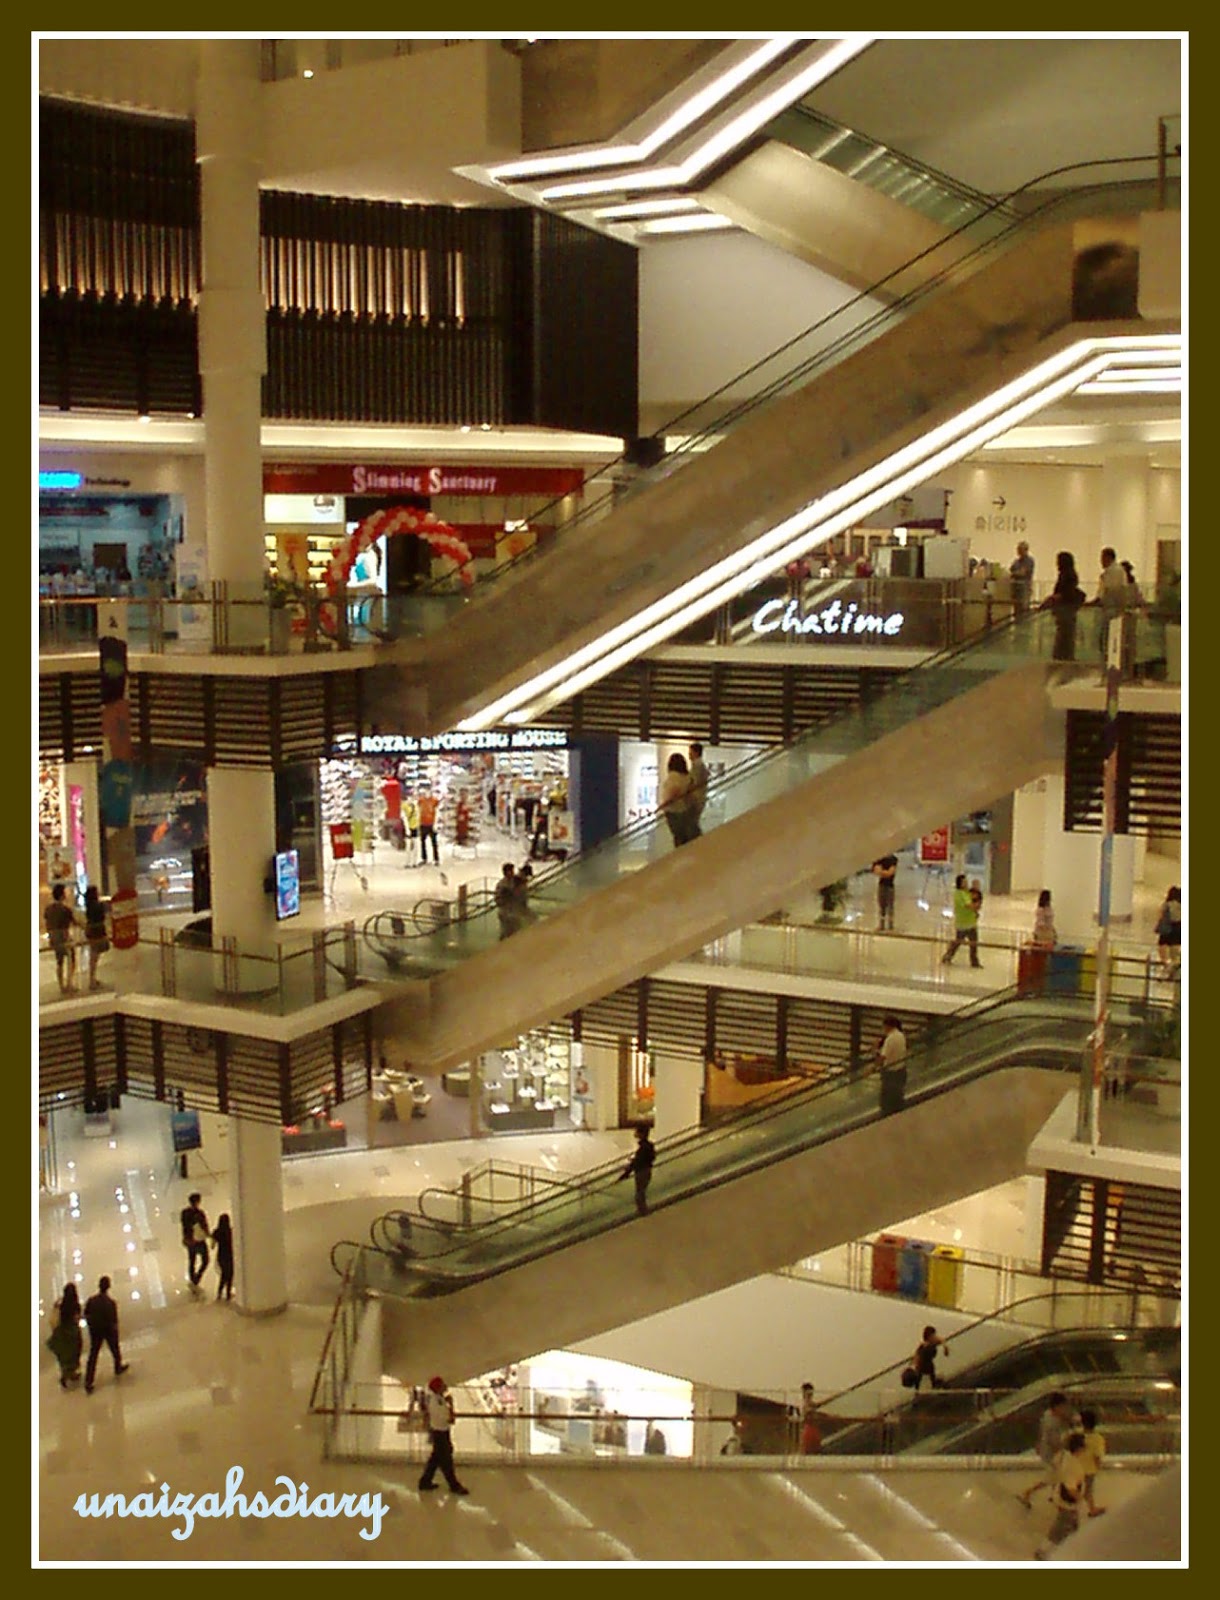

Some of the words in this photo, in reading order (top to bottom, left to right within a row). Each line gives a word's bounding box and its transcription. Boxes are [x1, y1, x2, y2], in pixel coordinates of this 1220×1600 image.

[352, 466, 421, 492] Slimming
[429, 467, 497, 493] Sanctuary
[752, 599, 904, 634] Chatime
[361, 734, 419, 752] ROYAL
